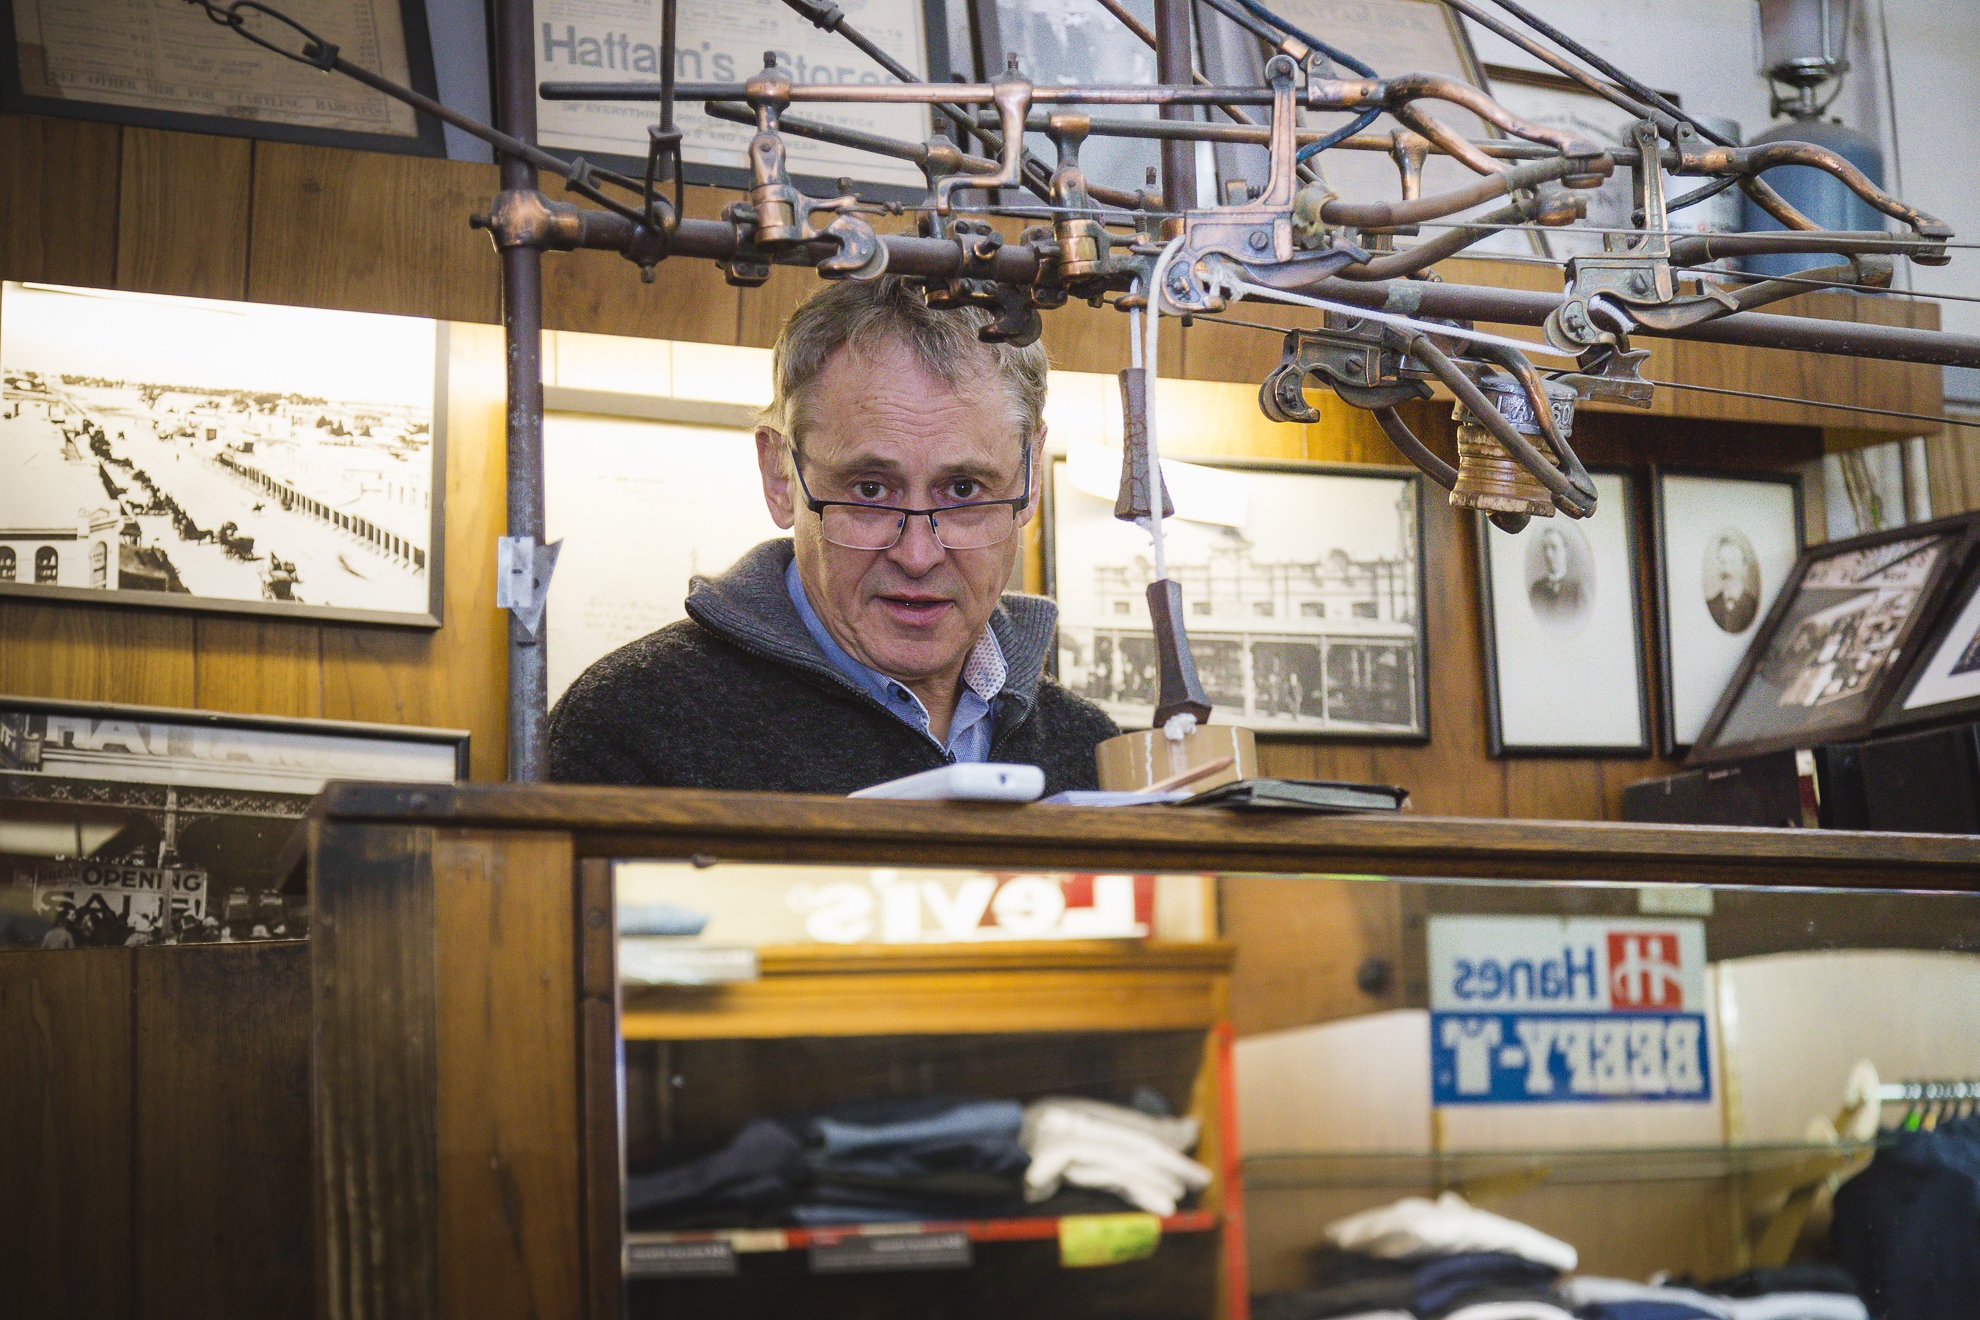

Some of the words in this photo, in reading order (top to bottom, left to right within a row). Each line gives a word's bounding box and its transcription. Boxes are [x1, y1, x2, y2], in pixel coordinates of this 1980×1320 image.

[542, 22, 736, 82] Hattam's
[586, 104, 661, 120] EVERYTHIN
[82, 866, 202, 891] OPENING
